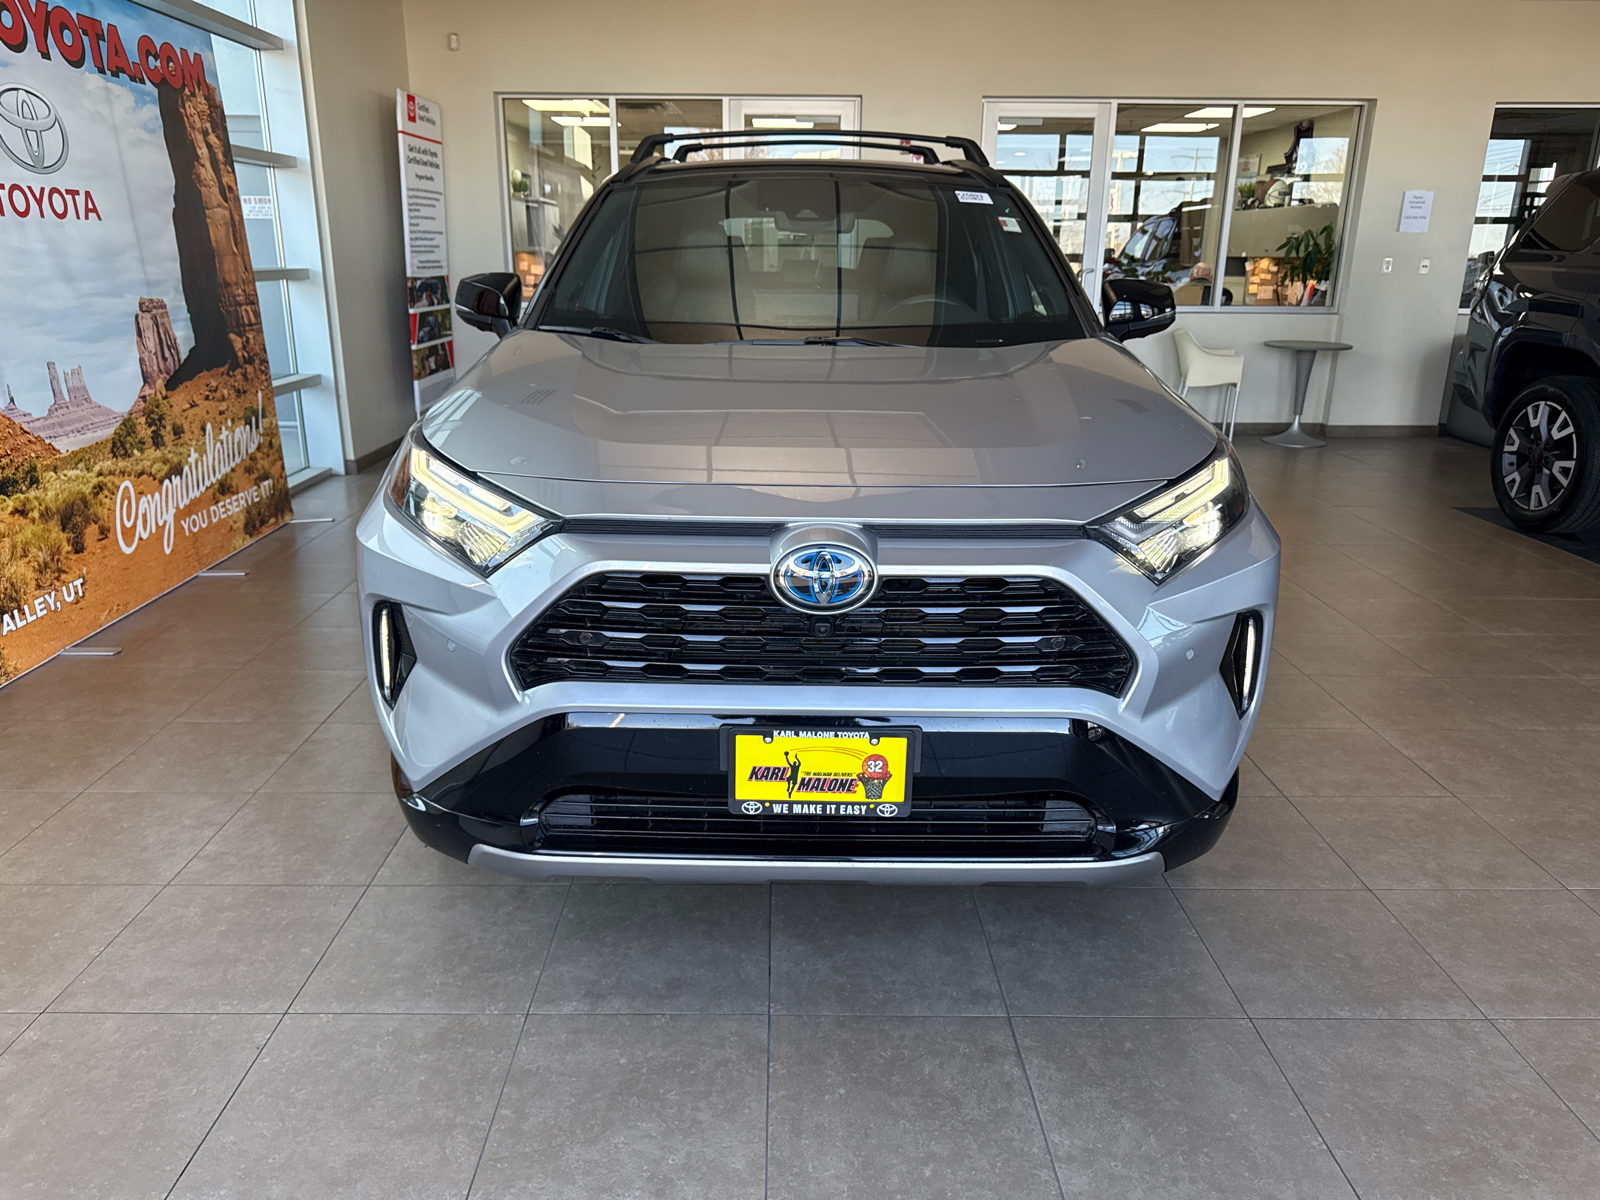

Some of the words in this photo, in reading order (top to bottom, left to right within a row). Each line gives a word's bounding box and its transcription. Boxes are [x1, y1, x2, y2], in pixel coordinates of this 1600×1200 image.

[115, 390, 263, 555] Congratulations!
[180, 509, 208, 537] YOU
[209, 485, 260, 524] DESERVE
[259, 478, 274, 499] IT!
[2, 590, 61, 637] ALLEY,
[61, 577, 84, 603] UT
[773, 730, 797, 738] KARL
[799, 731, 836, 739] MALONE
[837, 731, 870, 739] TOYOTA
[748, 766, 789, 782] KARL
[867, 760, 883, 773] 32
[796, 776, 859, 794] MALONE
[772, 803, 789, 814] WE
[792, 804, 823, 814] MAKE
[826, 804, 837, 815] IT
[839, 804, 867, 815] EASY
